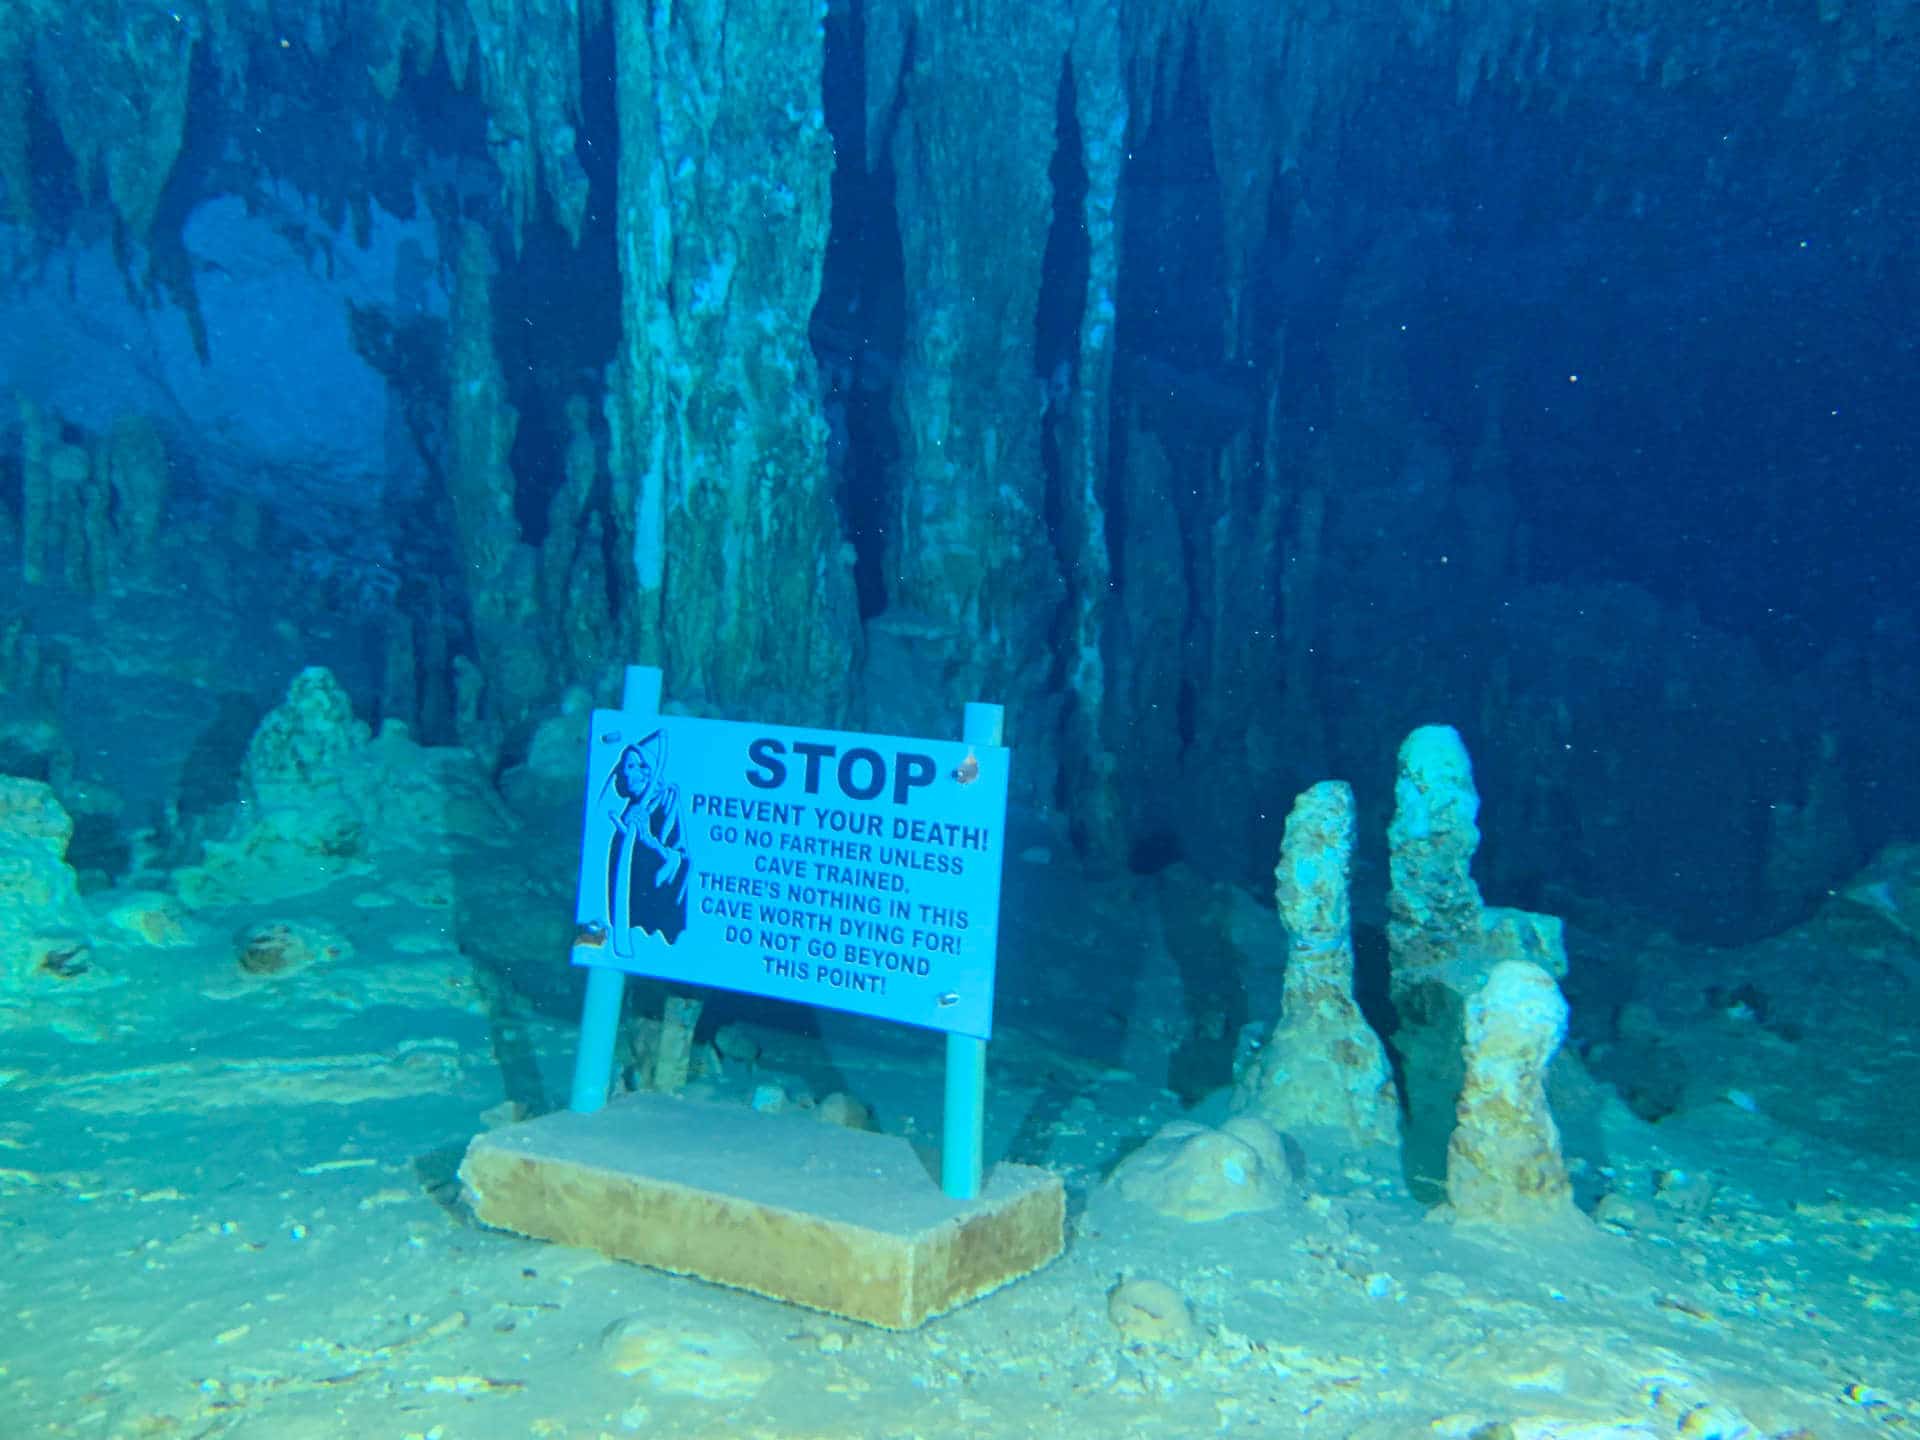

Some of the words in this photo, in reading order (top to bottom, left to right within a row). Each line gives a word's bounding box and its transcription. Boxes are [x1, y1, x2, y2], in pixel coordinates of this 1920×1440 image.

[746, 738, 936, 804] STOP
[692, 794, 805, 826] PREVENT
[814, 808, 882, 836] YOUR
[893, 819, 989, 851] DEATH!
[710, 825, 737, 843] GO
[745, 829, 773, 848] NO
[780, 834, 871, 861] FARTHER
[880, 848, 963, 875] UNLESS
[754, 856, 806, 878] CAVE
[815, 864, 909, 893] TRAINED.
[699, 872, 780, 899] THERE'S
[789, 884, 880, 915] NOTHING
[890, 899, 910, 918] IN
[919, 905, 968, 929] THIS
[701, 899, 752, 921] CAVE
[759, 907, 831, 933] WORTH
[840, 919, 904, 944] DYING
[912, 932, 961, 955] FOR!
[726, 927, 752, 945] DO
[760, 933, 800, 953] NOT
[808, 940, 836, 960] GO
[844, 948, 929, 976] BEYOND
[763, 957, 809, 980] THIS
[817, 967, 886, 995] POINT!
